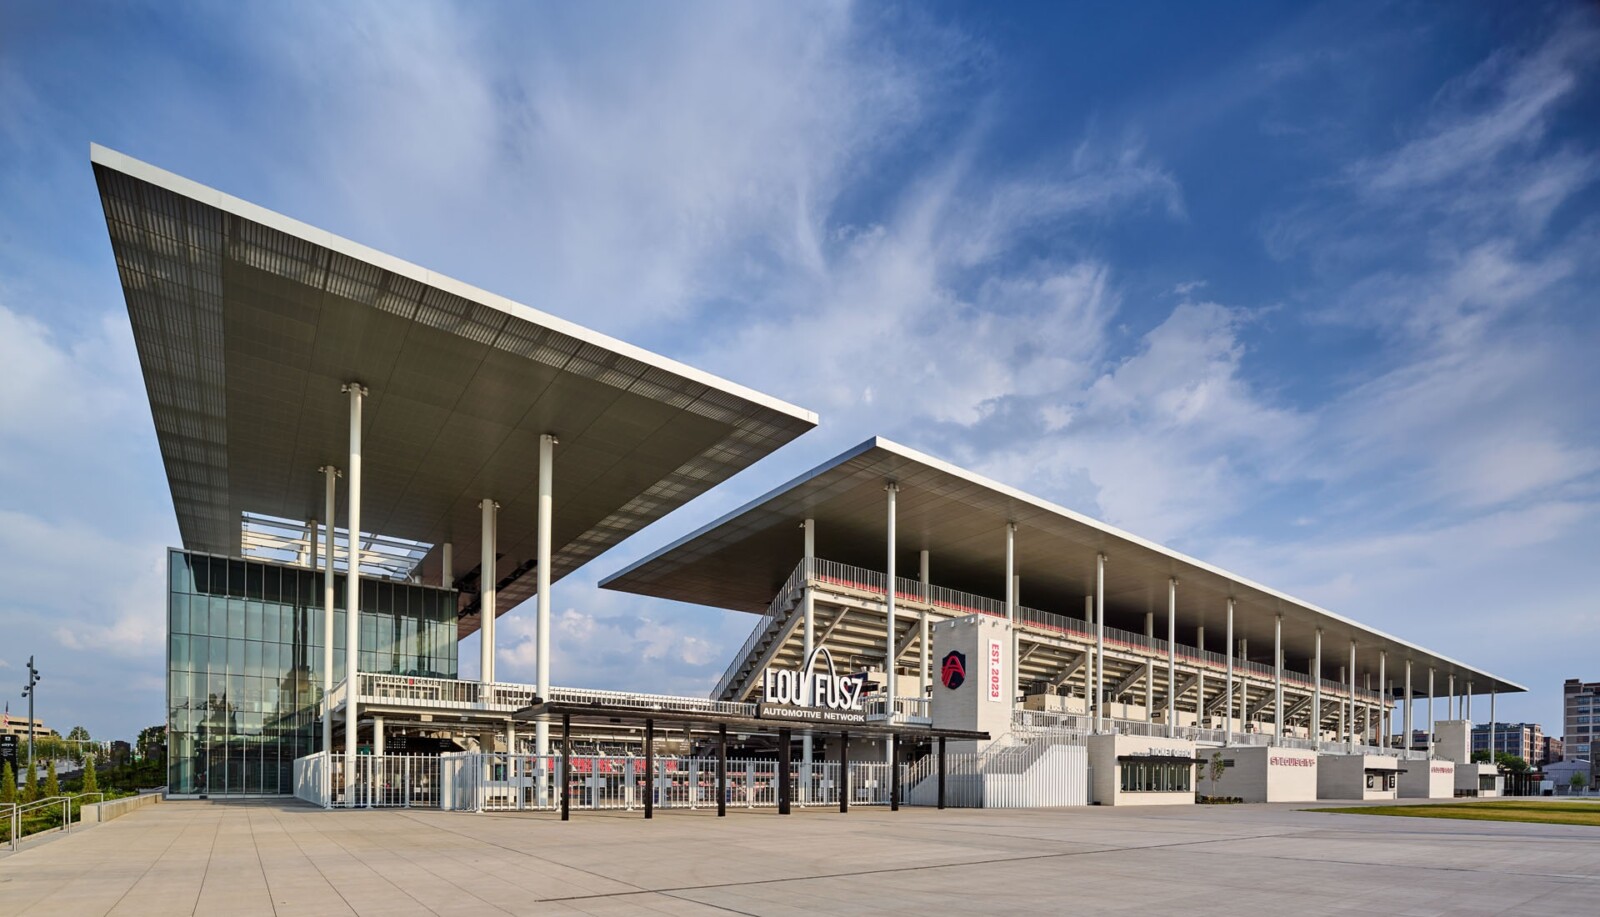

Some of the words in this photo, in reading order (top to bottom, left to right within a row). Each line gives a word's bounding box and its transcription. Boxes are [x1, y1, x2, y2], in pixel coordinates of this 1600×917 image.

[991, 643, 999, 666] EST.
[764, 668, 807, 706] LOU
[814, 673, 863, 711] FUSZ
[991, 668, 999, 698] 2023
[763, 707, 821, 719] AUTOMOTIVE
[824, 712, 865, 723] NETWORK
